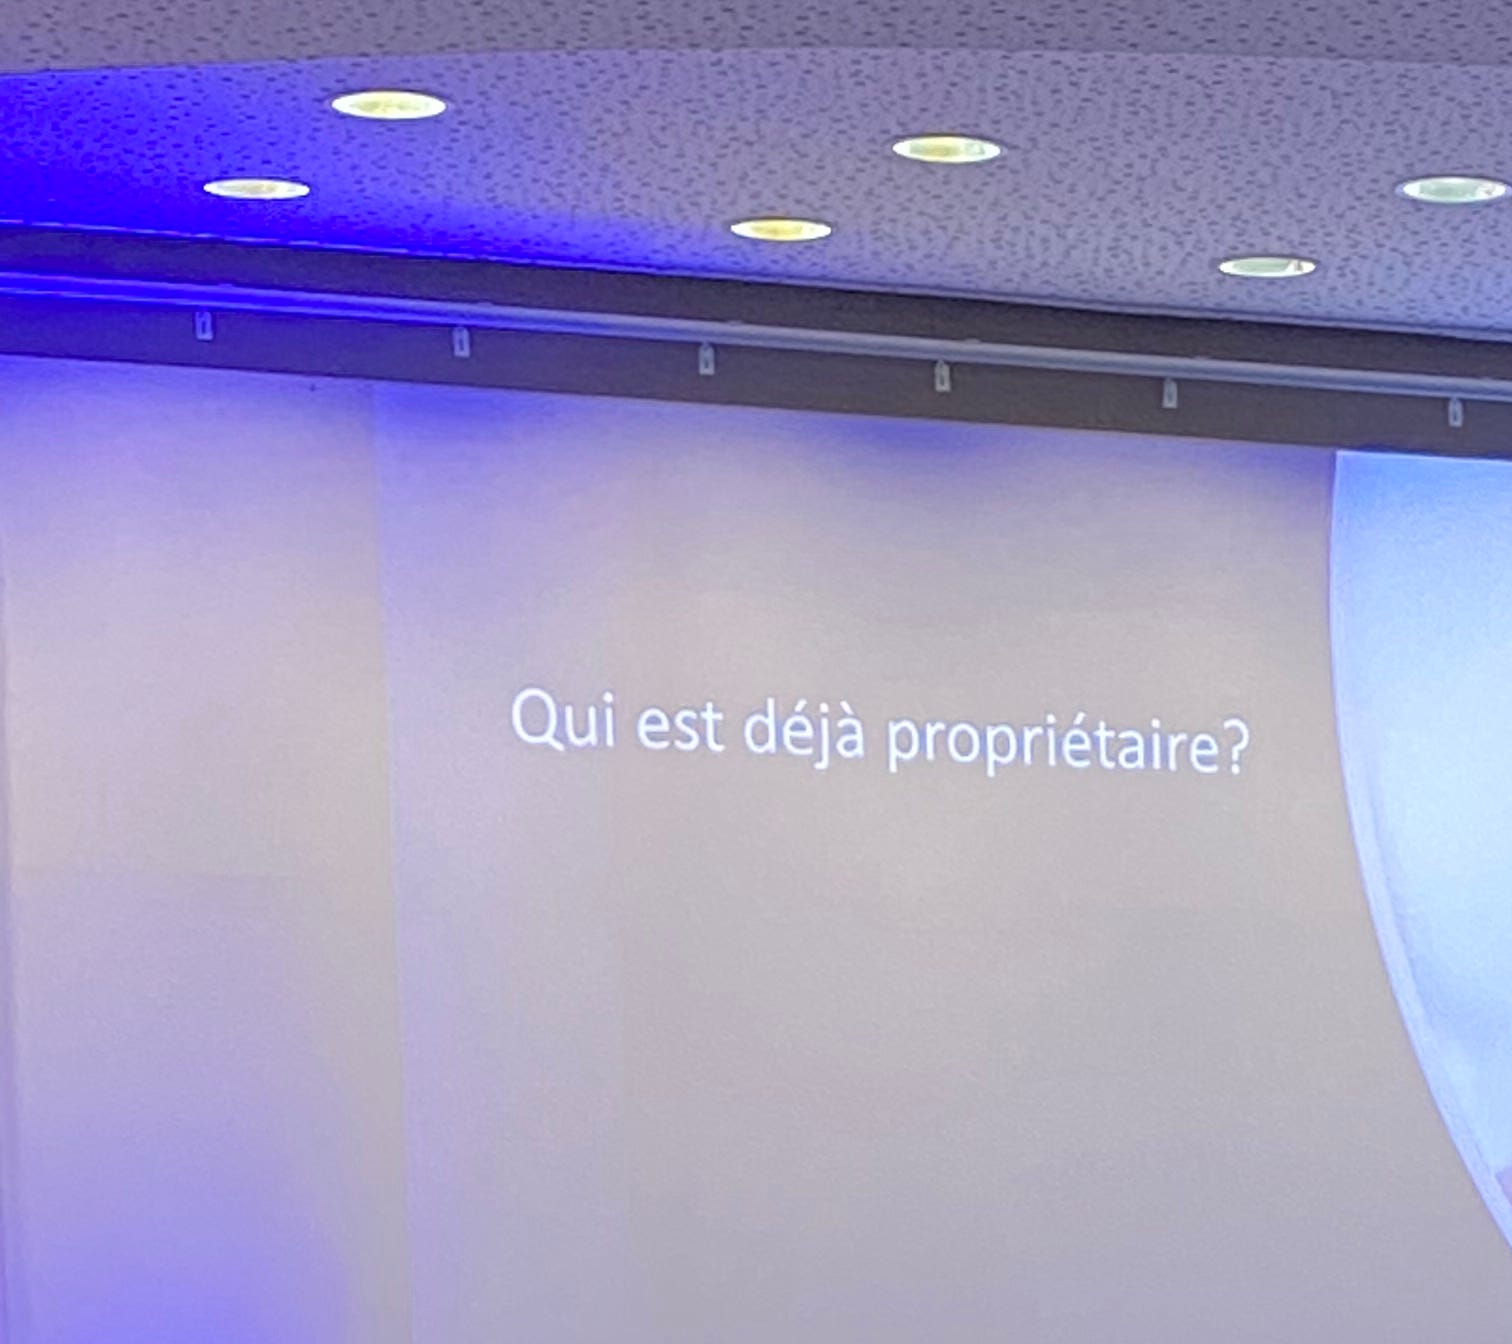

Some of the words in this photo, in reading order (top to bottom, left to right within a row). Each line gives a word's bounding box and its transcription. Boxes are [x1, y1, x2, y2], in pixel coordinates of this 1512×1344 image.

[511, 687, 615, 753] Qui
[637, 701, 726, 755] est
[744, 698, 866, 770] déjà
[888, 711, 1250, 778] propriétaire?
